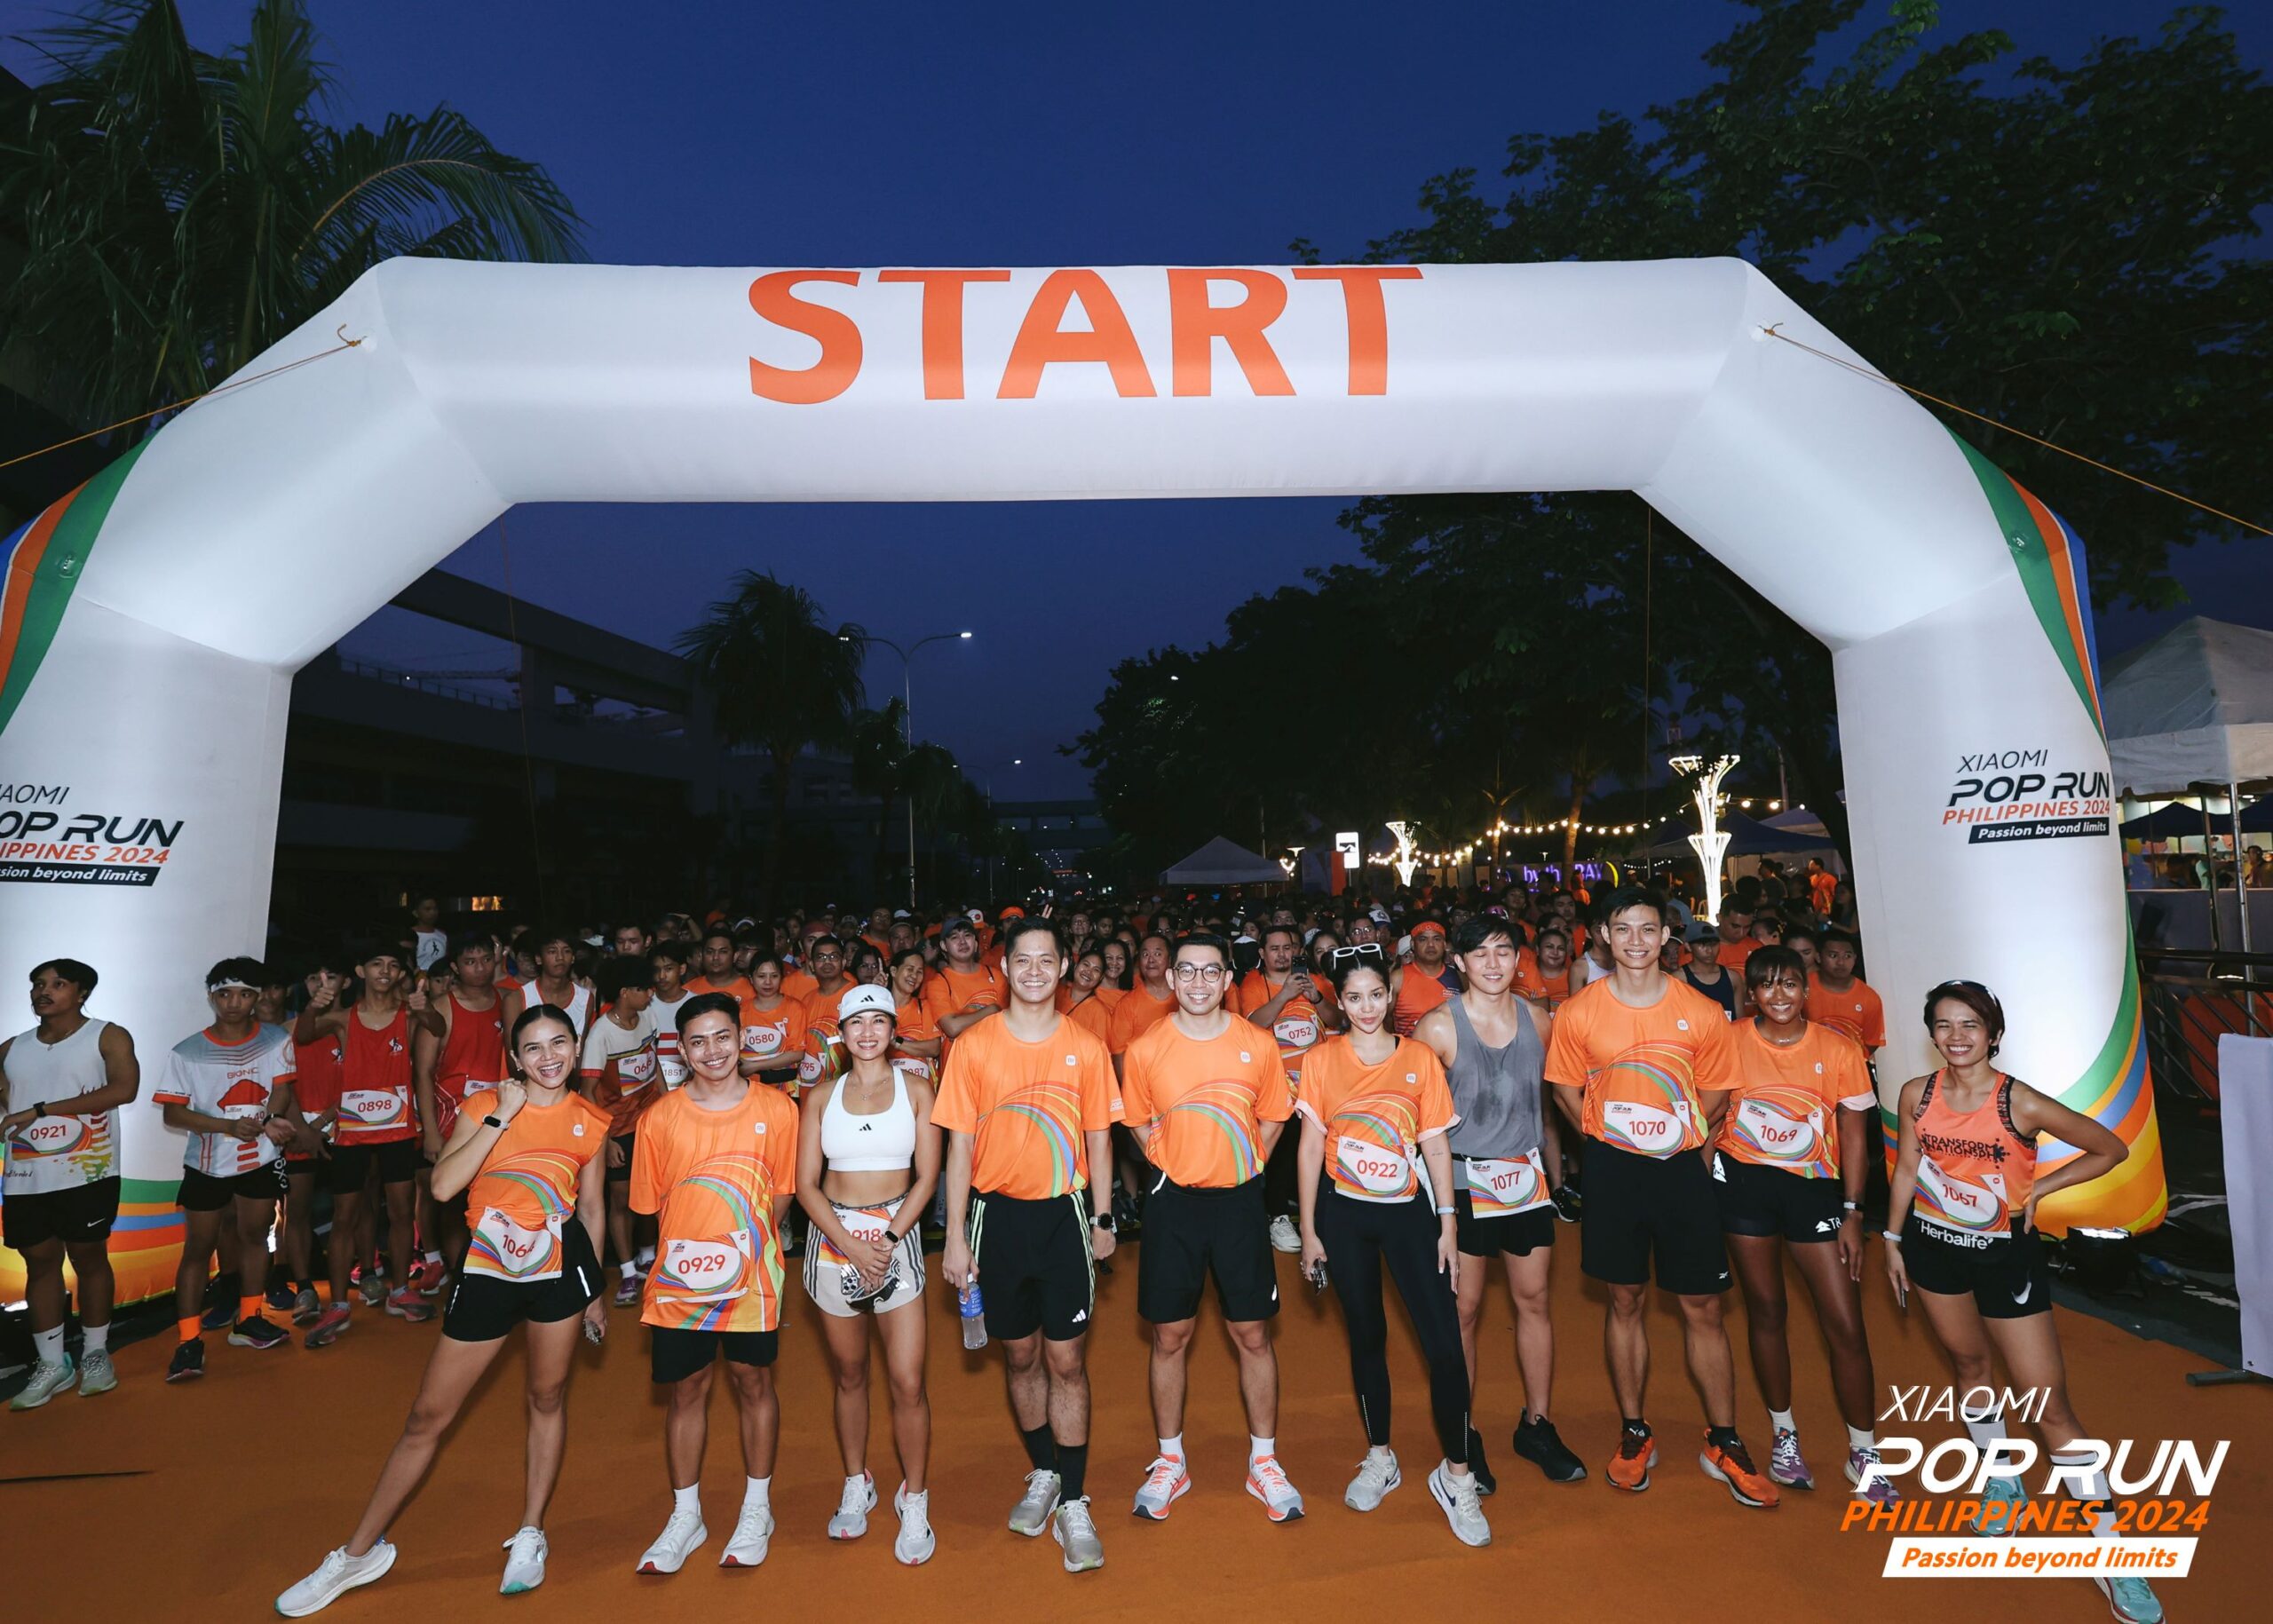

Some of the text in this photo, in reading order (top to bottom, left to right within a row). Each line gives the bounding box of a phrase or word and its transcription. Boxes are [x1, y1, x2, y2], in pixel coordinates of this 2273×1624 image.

[748, 267, 1423, 404] START
[1956, 749, 2048, 774] XIAOMI
[0, 784, 70, 805] AOMI
[1946, 772, 2110, 807] POP RUN
[1942, 800, 2110, 825] PHILIPPINES 2024
[0, 811, 185, 847] OP RUN
[1977, 821, 2107, 839] Passion beyond limits
[0, 843, 170, 864] IPPINES 2024
[0, 865, 148, 882] sion beyond limits
[748, 1033, 775, 1045] 0580
[1288, 1026, 1312, 1040] 0752
[357, 1099, 392, 1113] 0898
[30, 1124, 67, 1140] 0921
[1628, 1121, 1667, 1136] 1070
[1760, 1125, 1797, 1142] 1069
[1357, 1160, 1398, 1178] 0922
[1491, 1170, 1521, 1191] 1077
[1943, 1184, 1977, 1208] 1067
[1827, 1216, 1842, 1230] T8
[851, 1228, 882, 1243] 918
[1921, 1221, 1989, 1249] Herbalife
[677, 1254, 726, 1274] 0929
